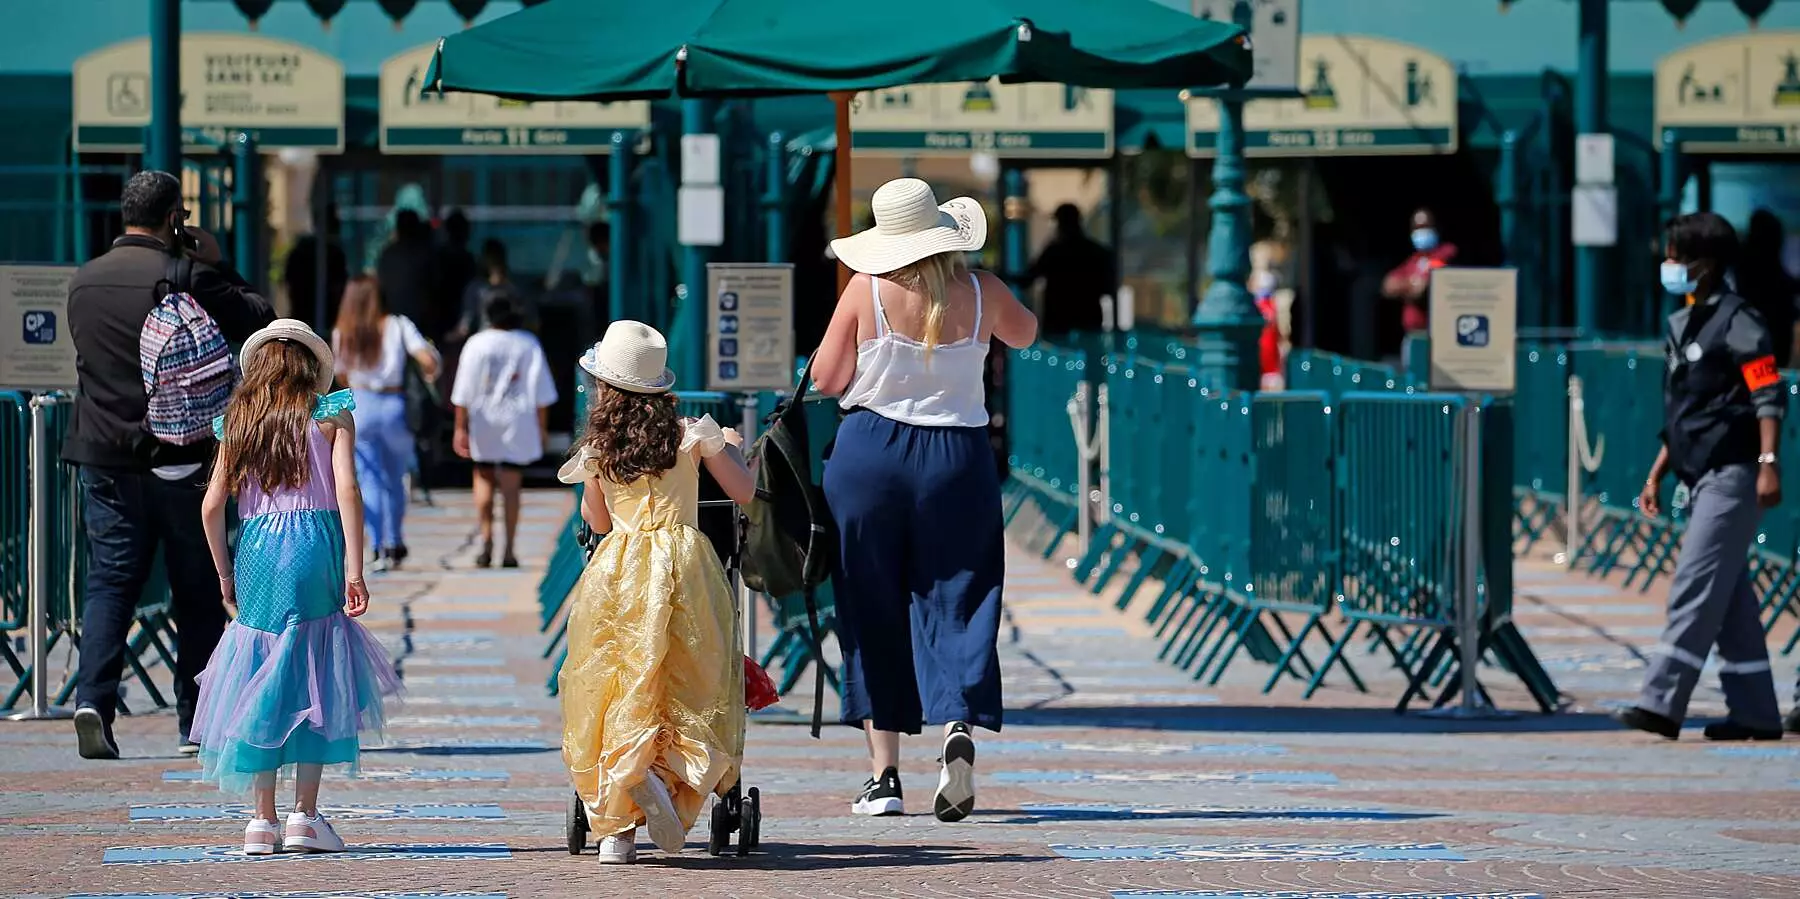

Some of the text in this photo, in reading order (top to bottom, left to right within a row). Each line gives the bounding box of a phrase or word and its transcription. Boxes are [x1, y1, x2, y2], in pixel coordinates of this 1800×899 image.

[206, 54, 301, 67] VISITEURS
[206, 69, 294, 84] SANS SAC
[506, 128, 530, 148] 11
